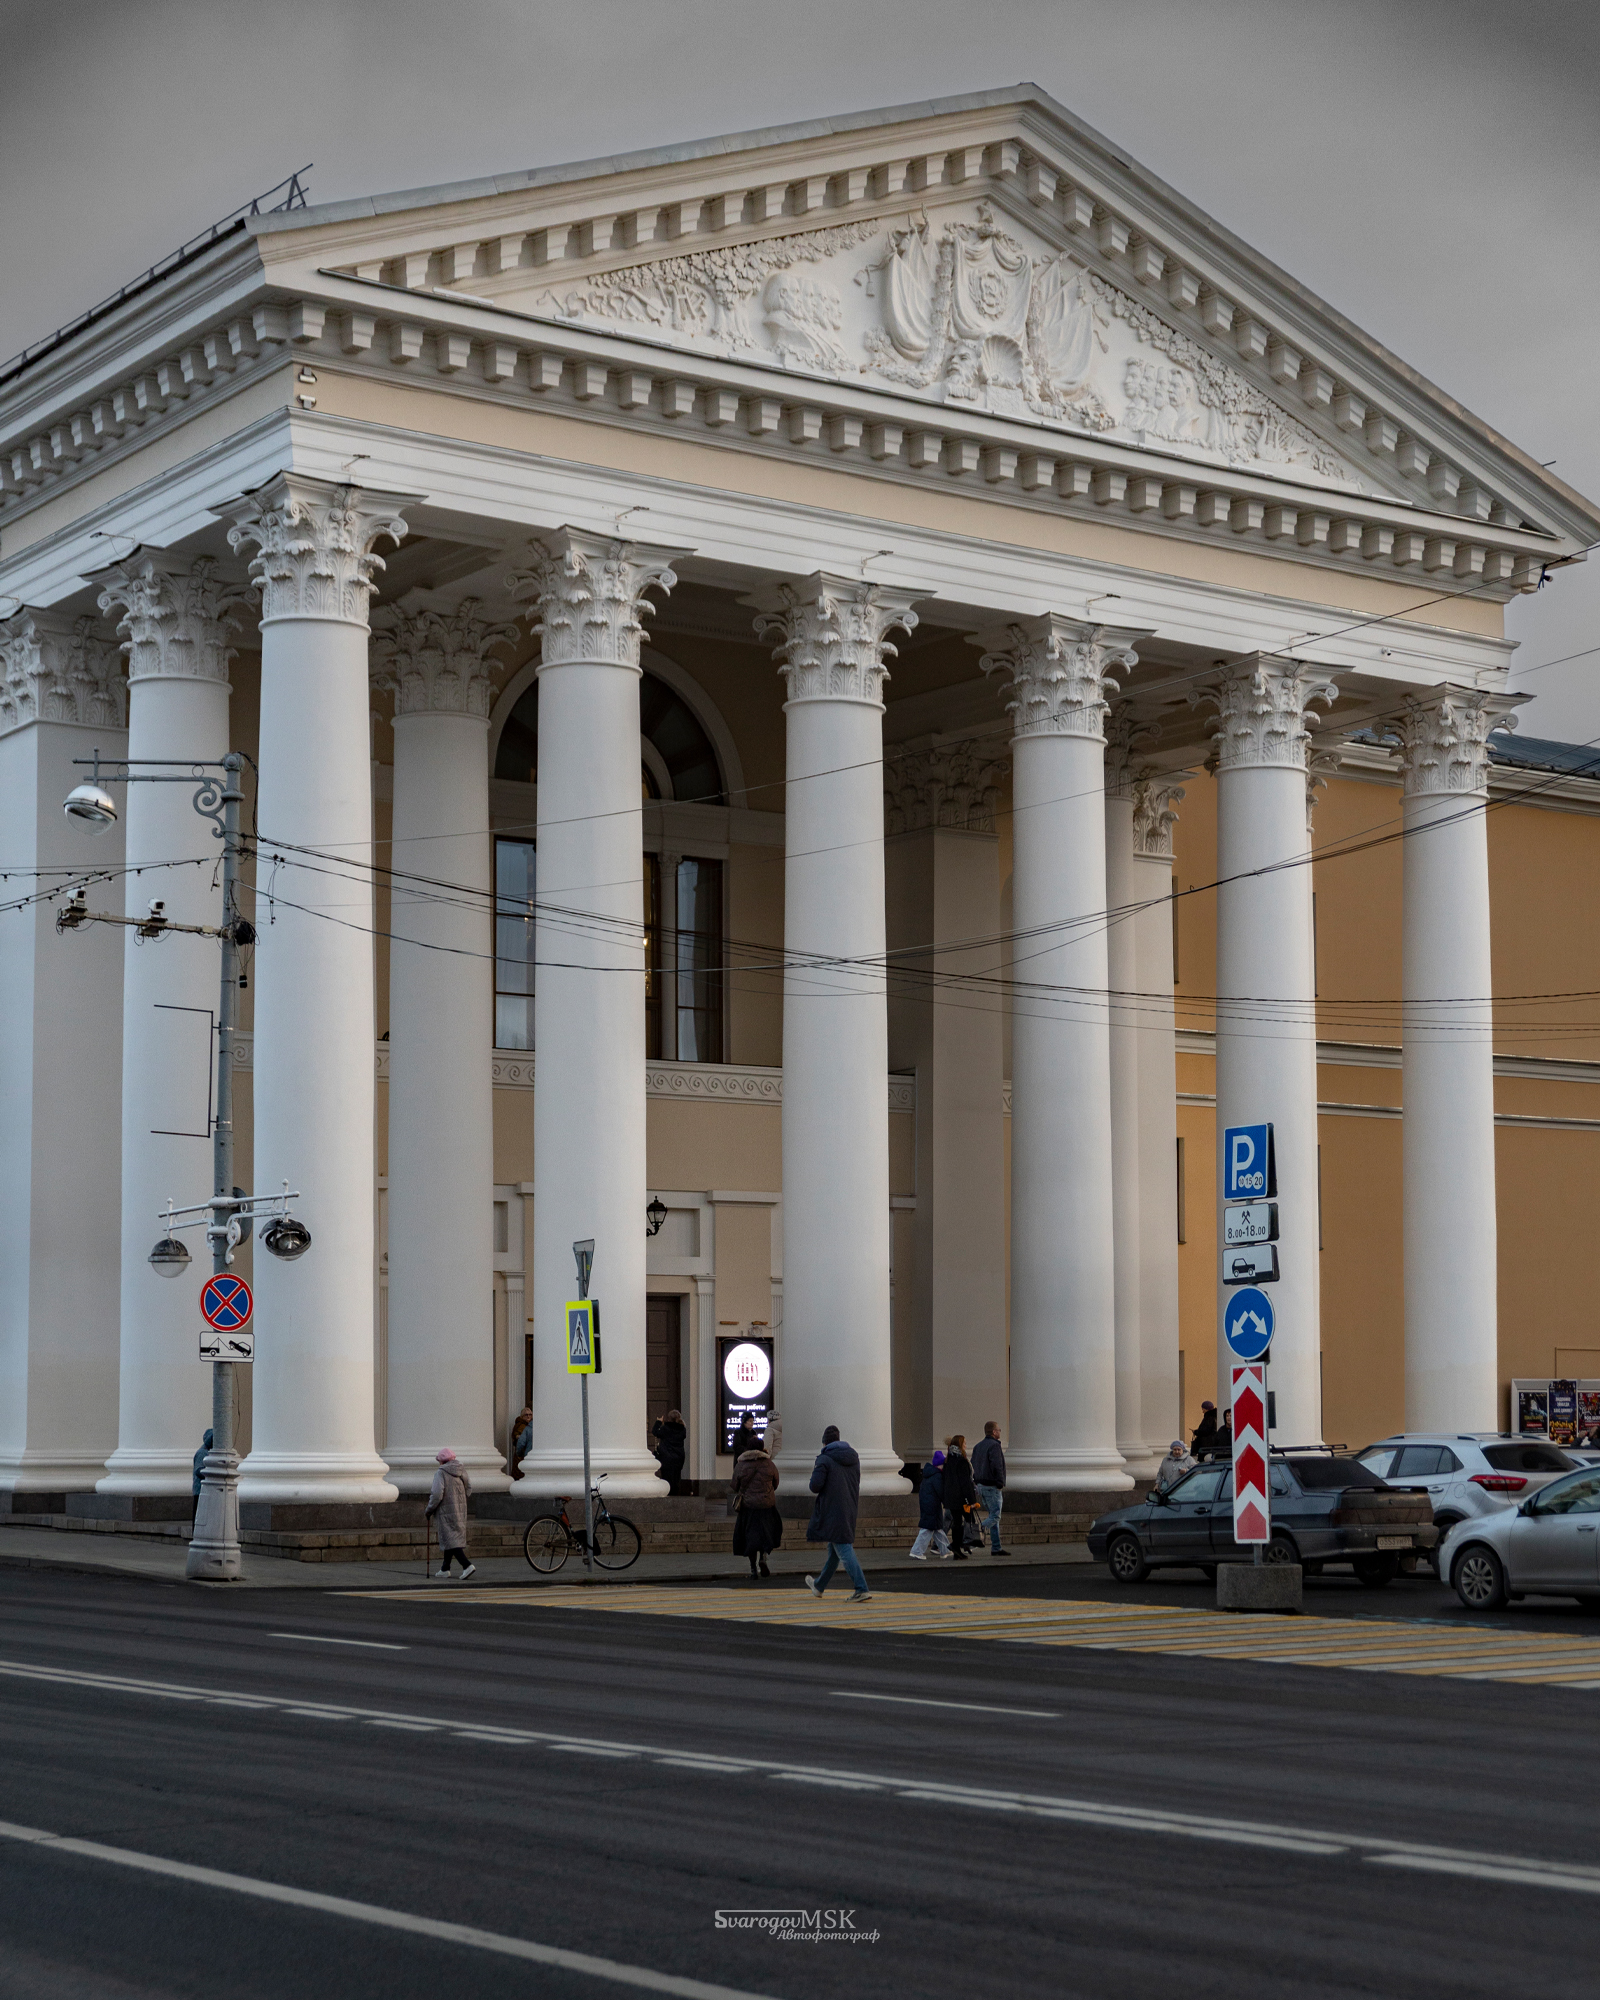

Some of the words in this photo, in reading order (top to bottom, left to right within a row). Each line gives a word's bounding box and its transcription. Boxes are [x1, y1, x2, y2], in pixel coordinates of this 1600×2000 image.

[1231, 1134, 1255, 1191] P
[1245, 1176, 1253, 1186] 15
[1254, 1175, 1263, 1186] 20
